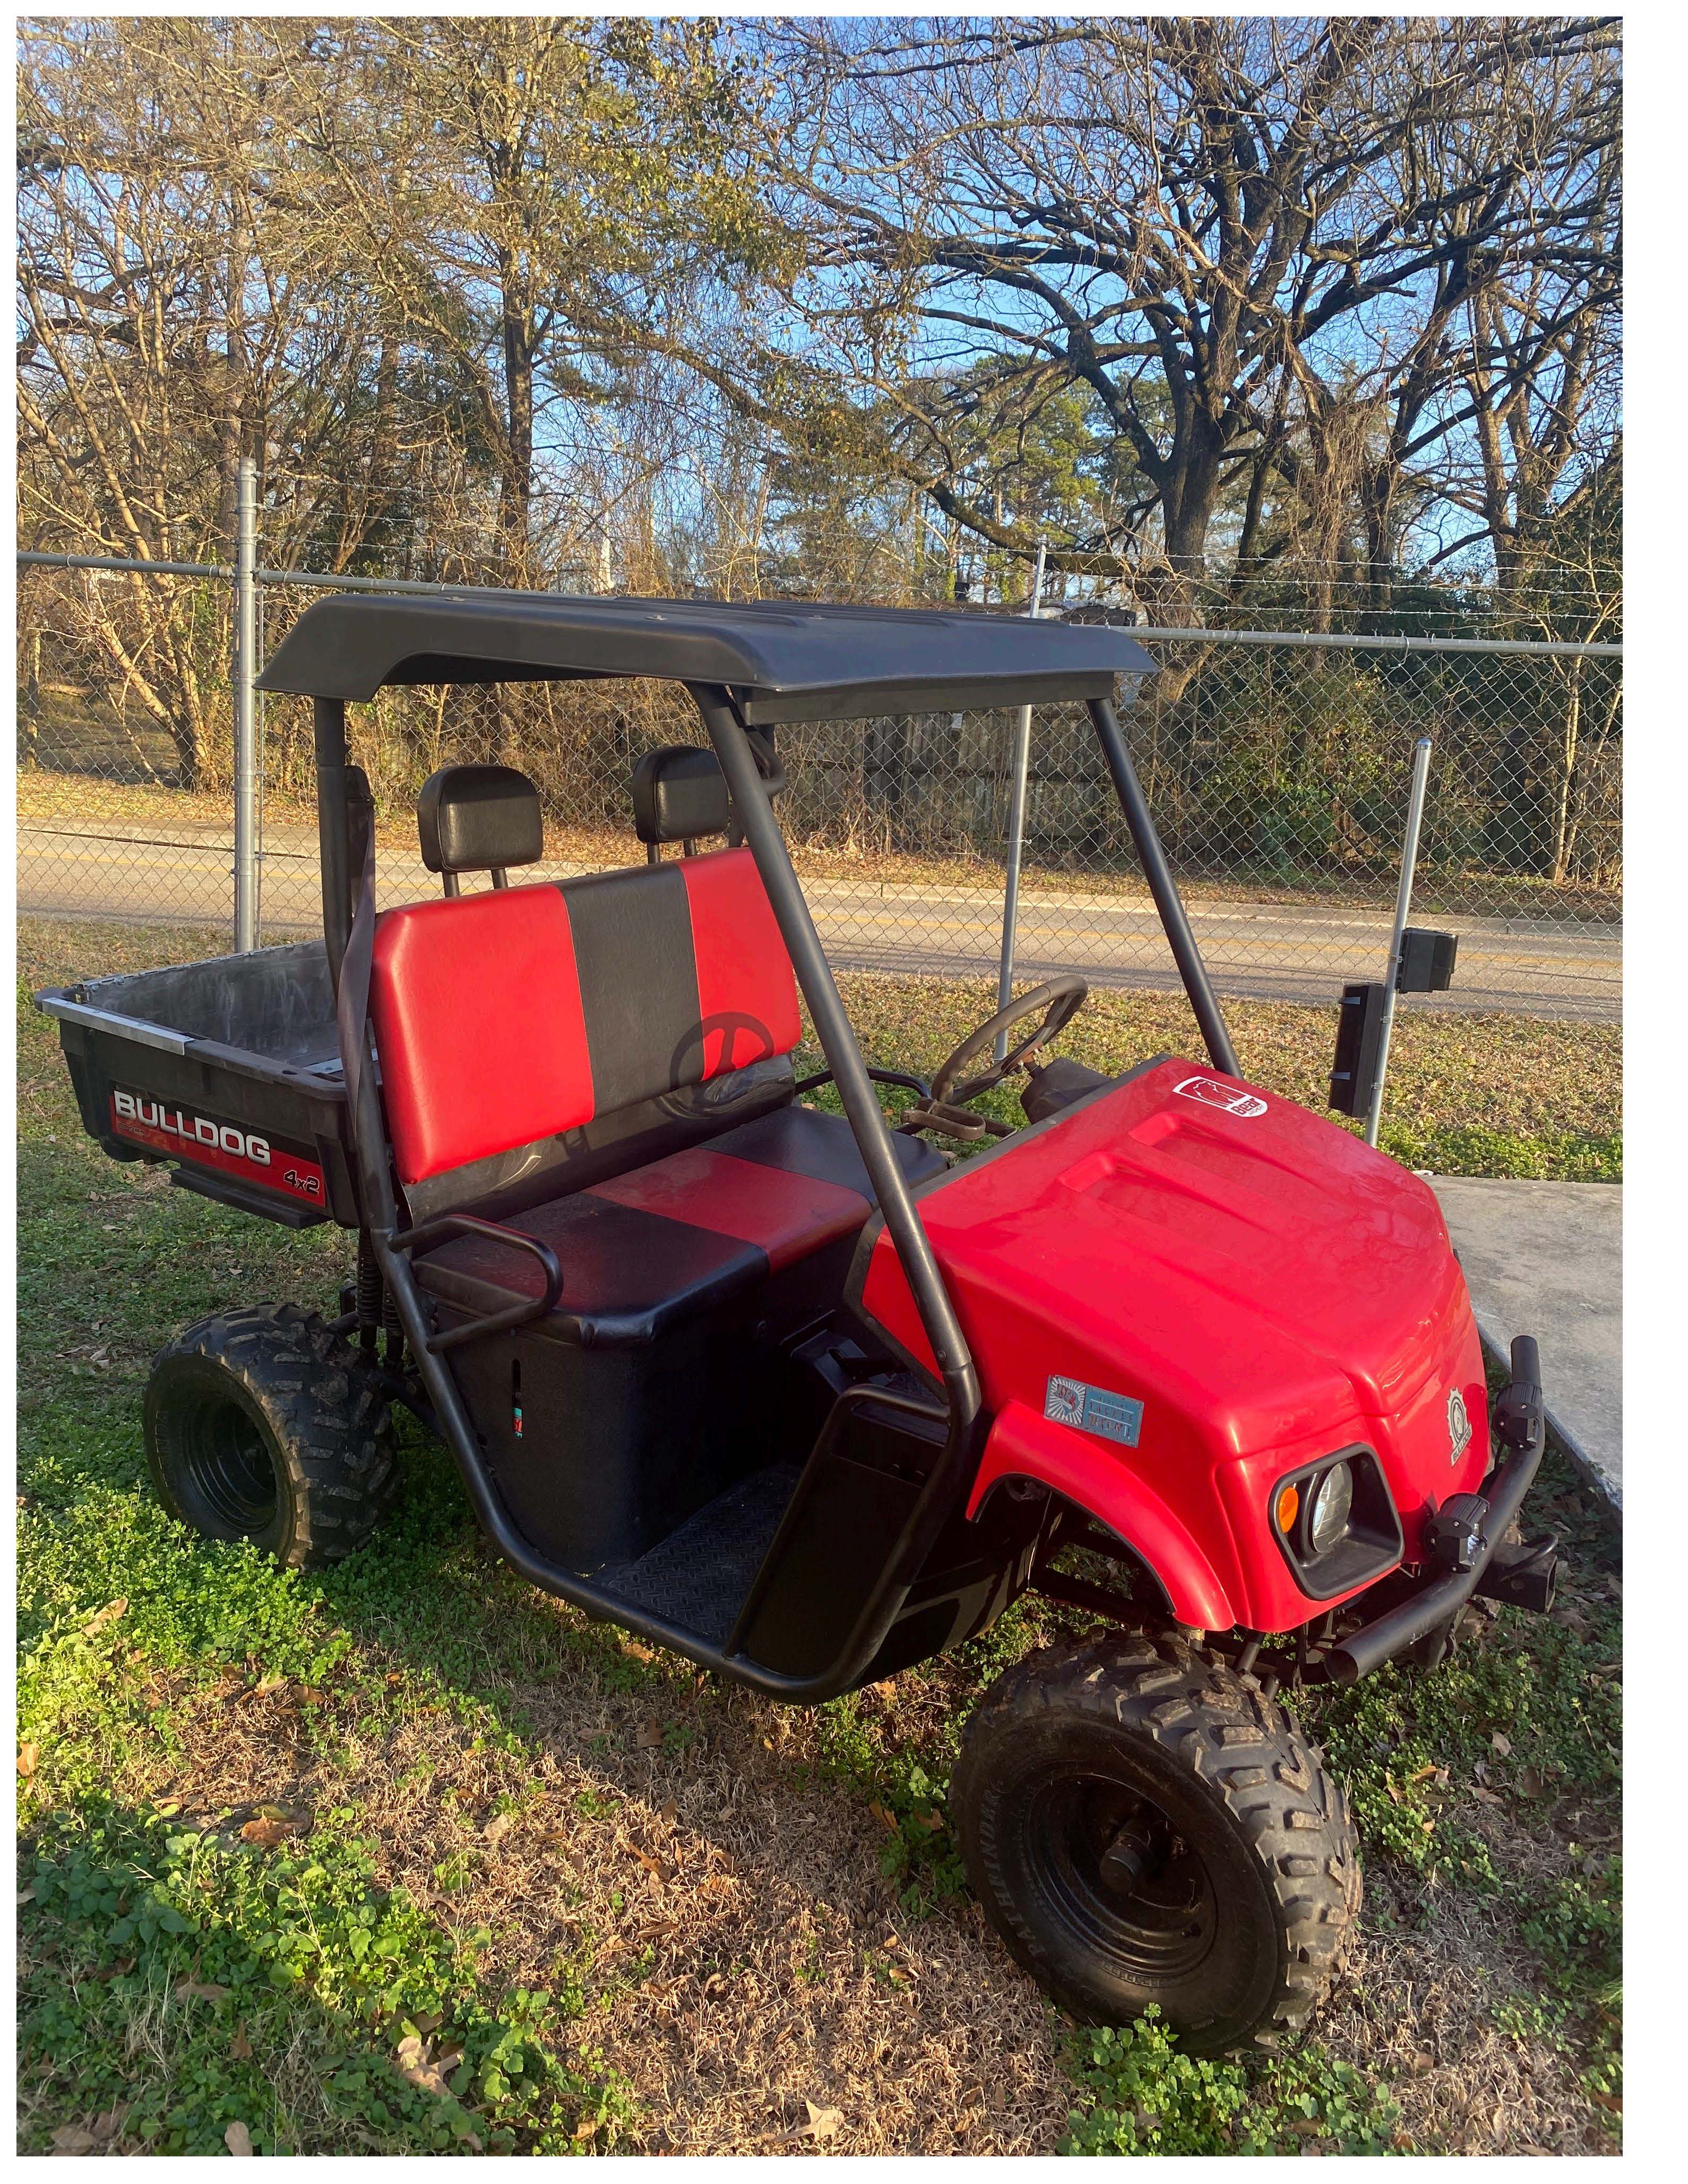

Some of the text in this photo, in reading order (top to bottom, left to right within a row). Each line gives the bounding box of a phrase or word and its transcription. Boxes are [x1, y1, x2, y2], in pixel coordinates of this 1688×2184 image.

[1230, 1097, 1261, 1115] Bear
[114, 1090, 271, 1166] BULLDOG
[283, 1170, 320, 1195] 4x2
